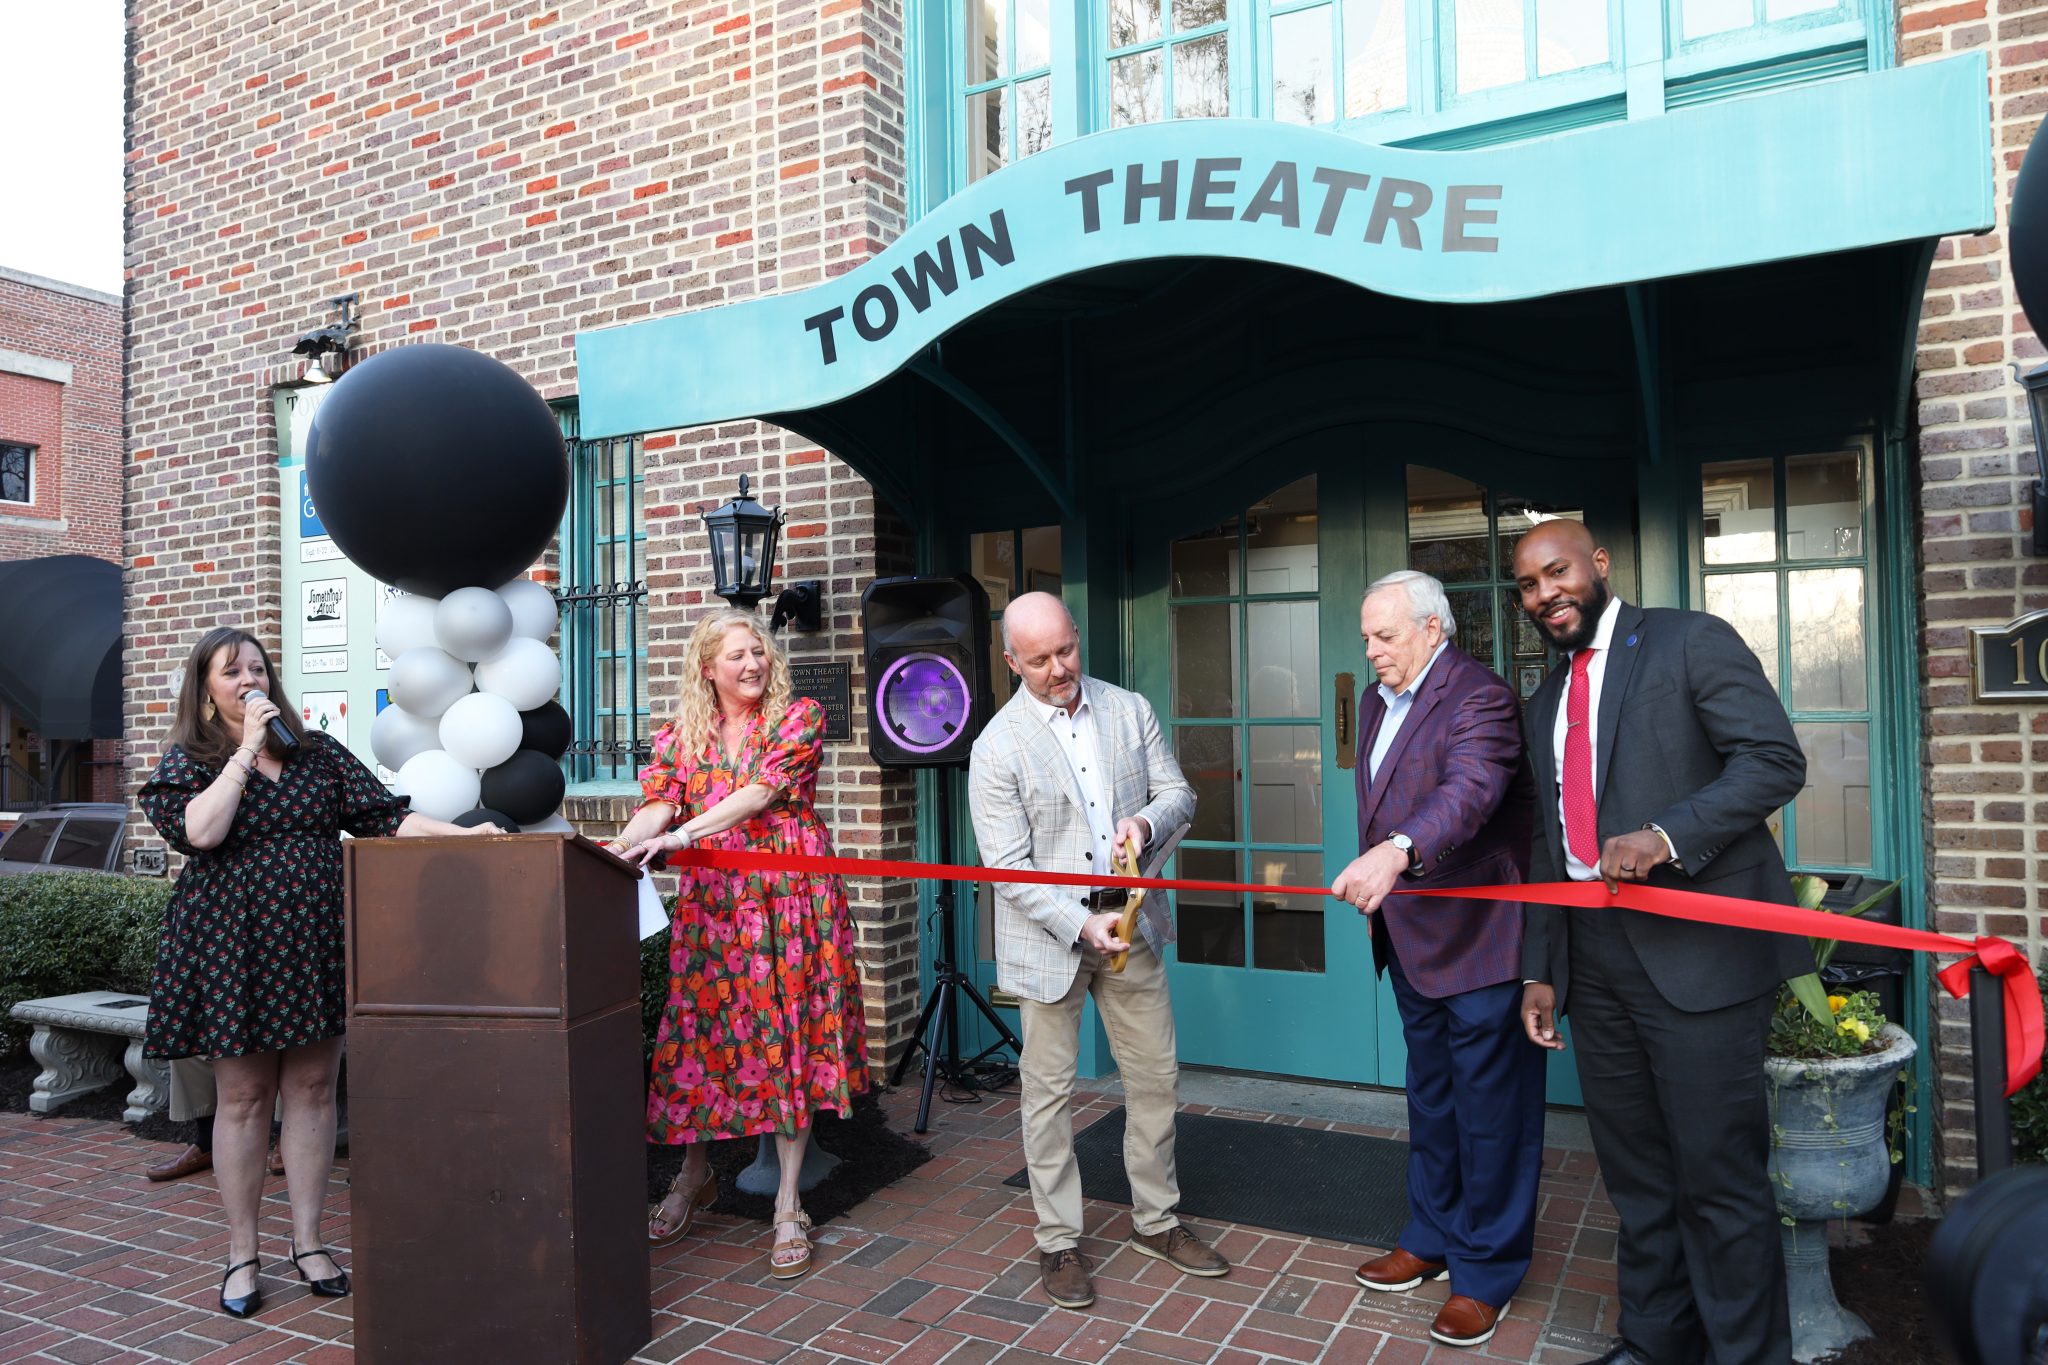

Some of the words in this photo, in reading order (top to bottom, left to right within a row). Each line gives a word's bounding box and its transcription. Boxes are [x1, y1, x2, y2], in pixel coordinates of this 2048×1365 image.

[804, 208, 1016, 366] TOWN
[1064, 156, 1504, 254] THEATRE
[791, 669, 811, 677] TOWN
[814, 667, 845, 676] THEATRE
[1363, 1298, 1397, 1310] MILTON
